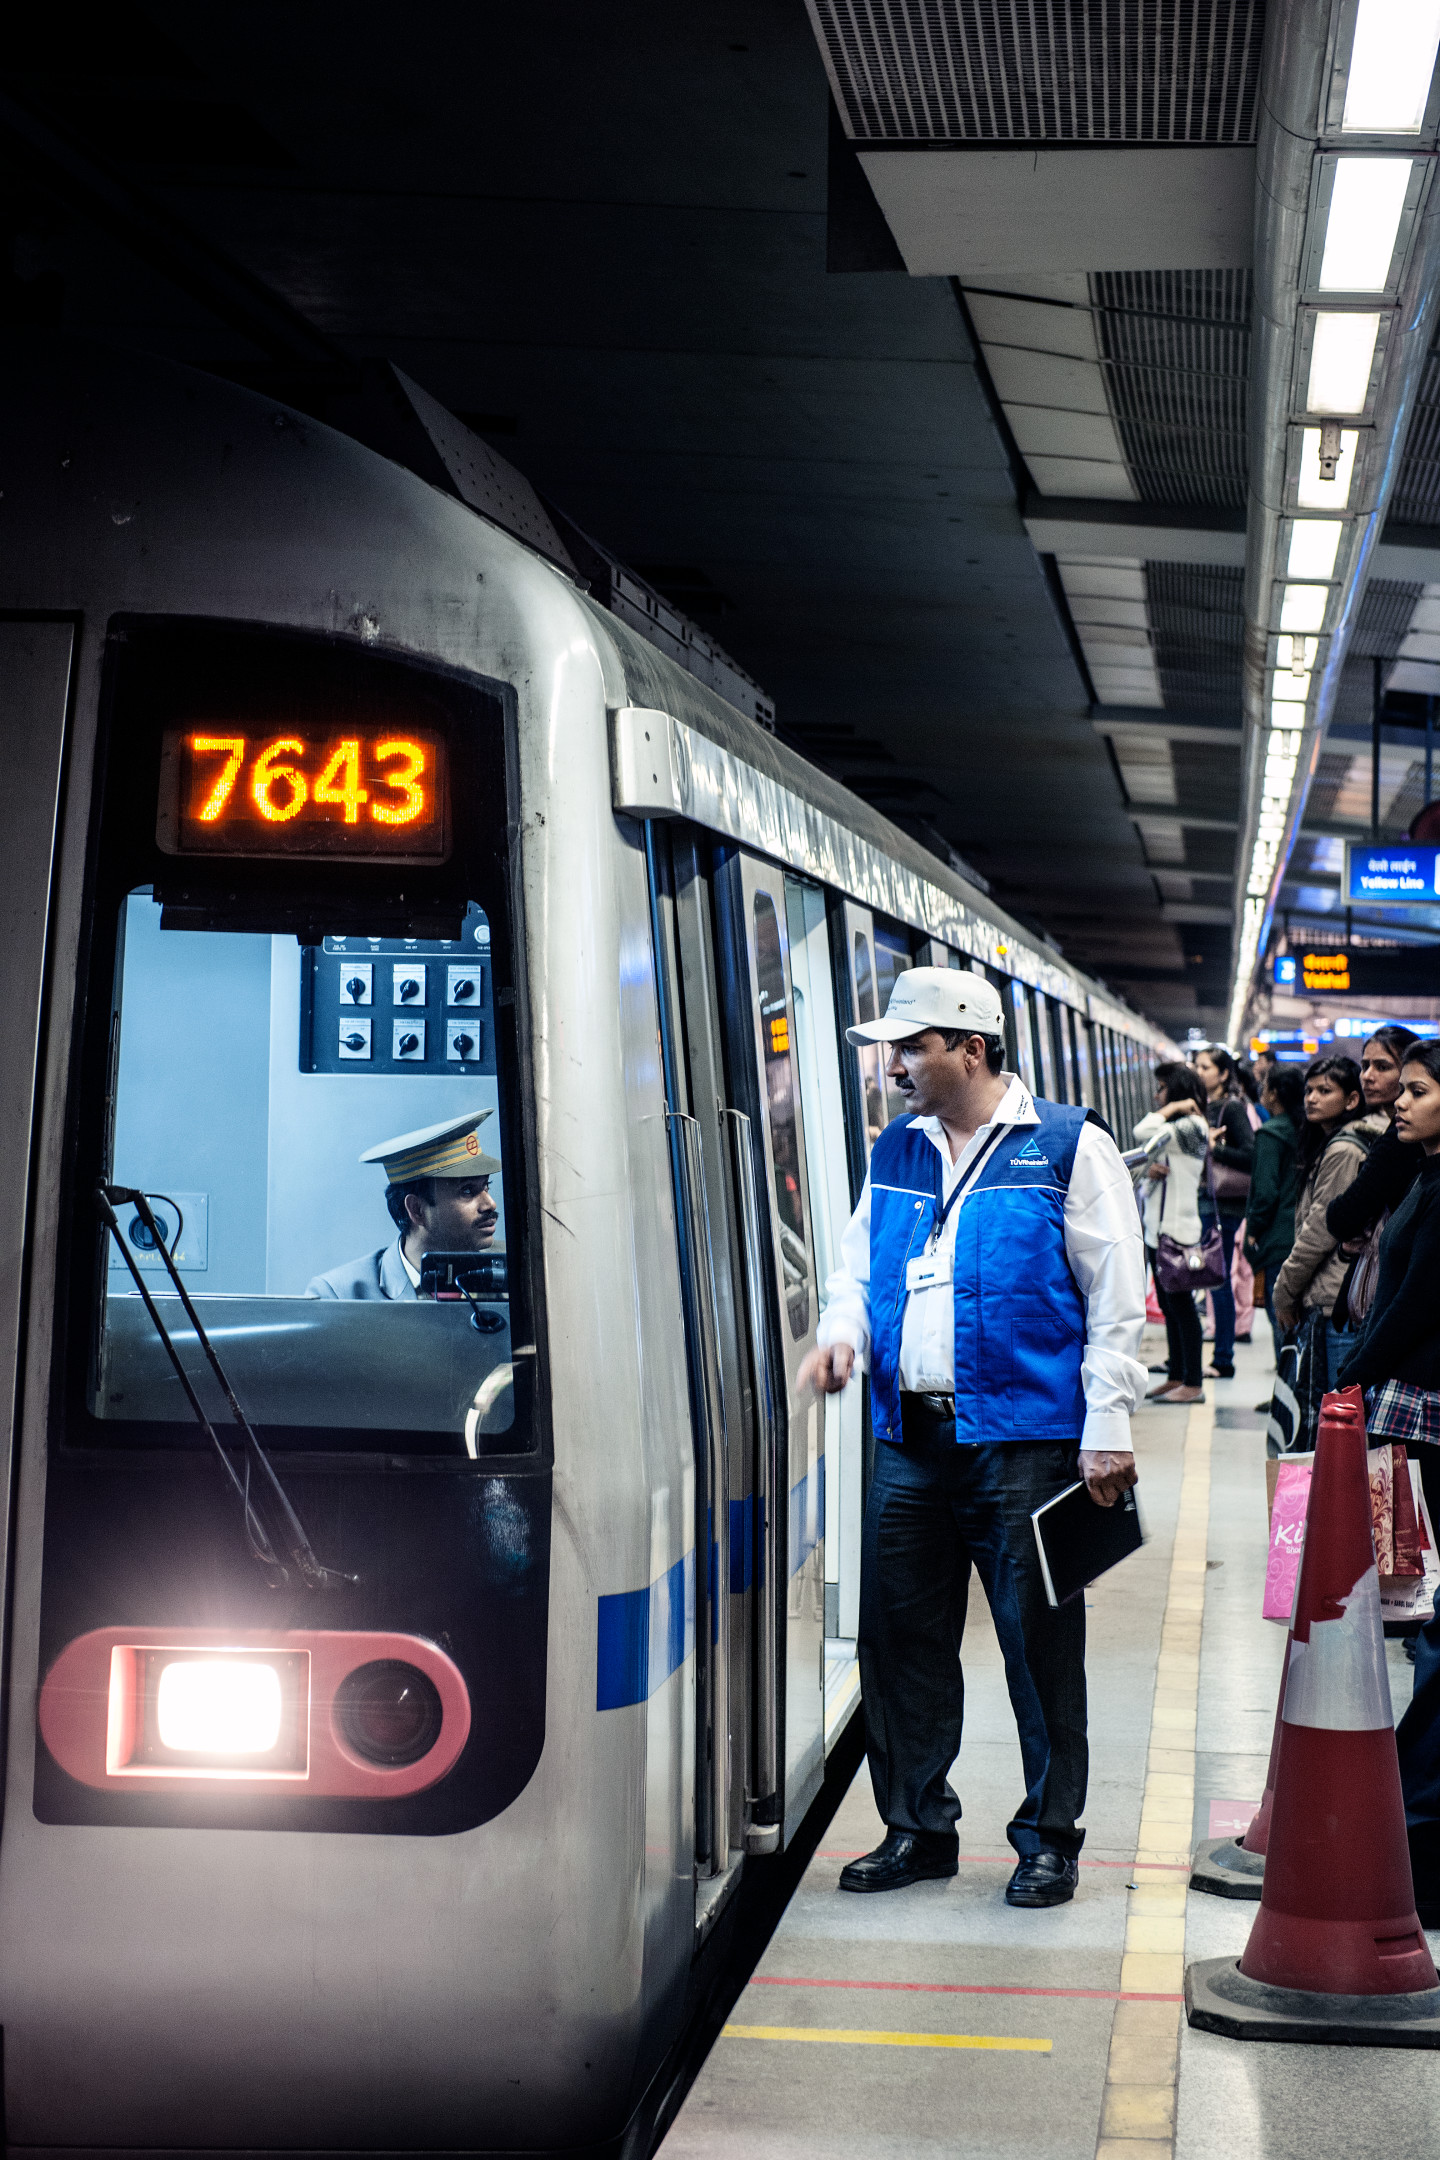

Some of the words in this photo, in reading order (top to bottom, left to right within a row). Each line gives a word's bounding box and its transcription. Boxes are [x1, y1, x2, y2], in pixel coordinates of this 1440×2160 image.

[192, 736, 426, 825] 7643
[1360, 876, 1399, 890] Yellow
[1399, 876, 1425, 890] Line
